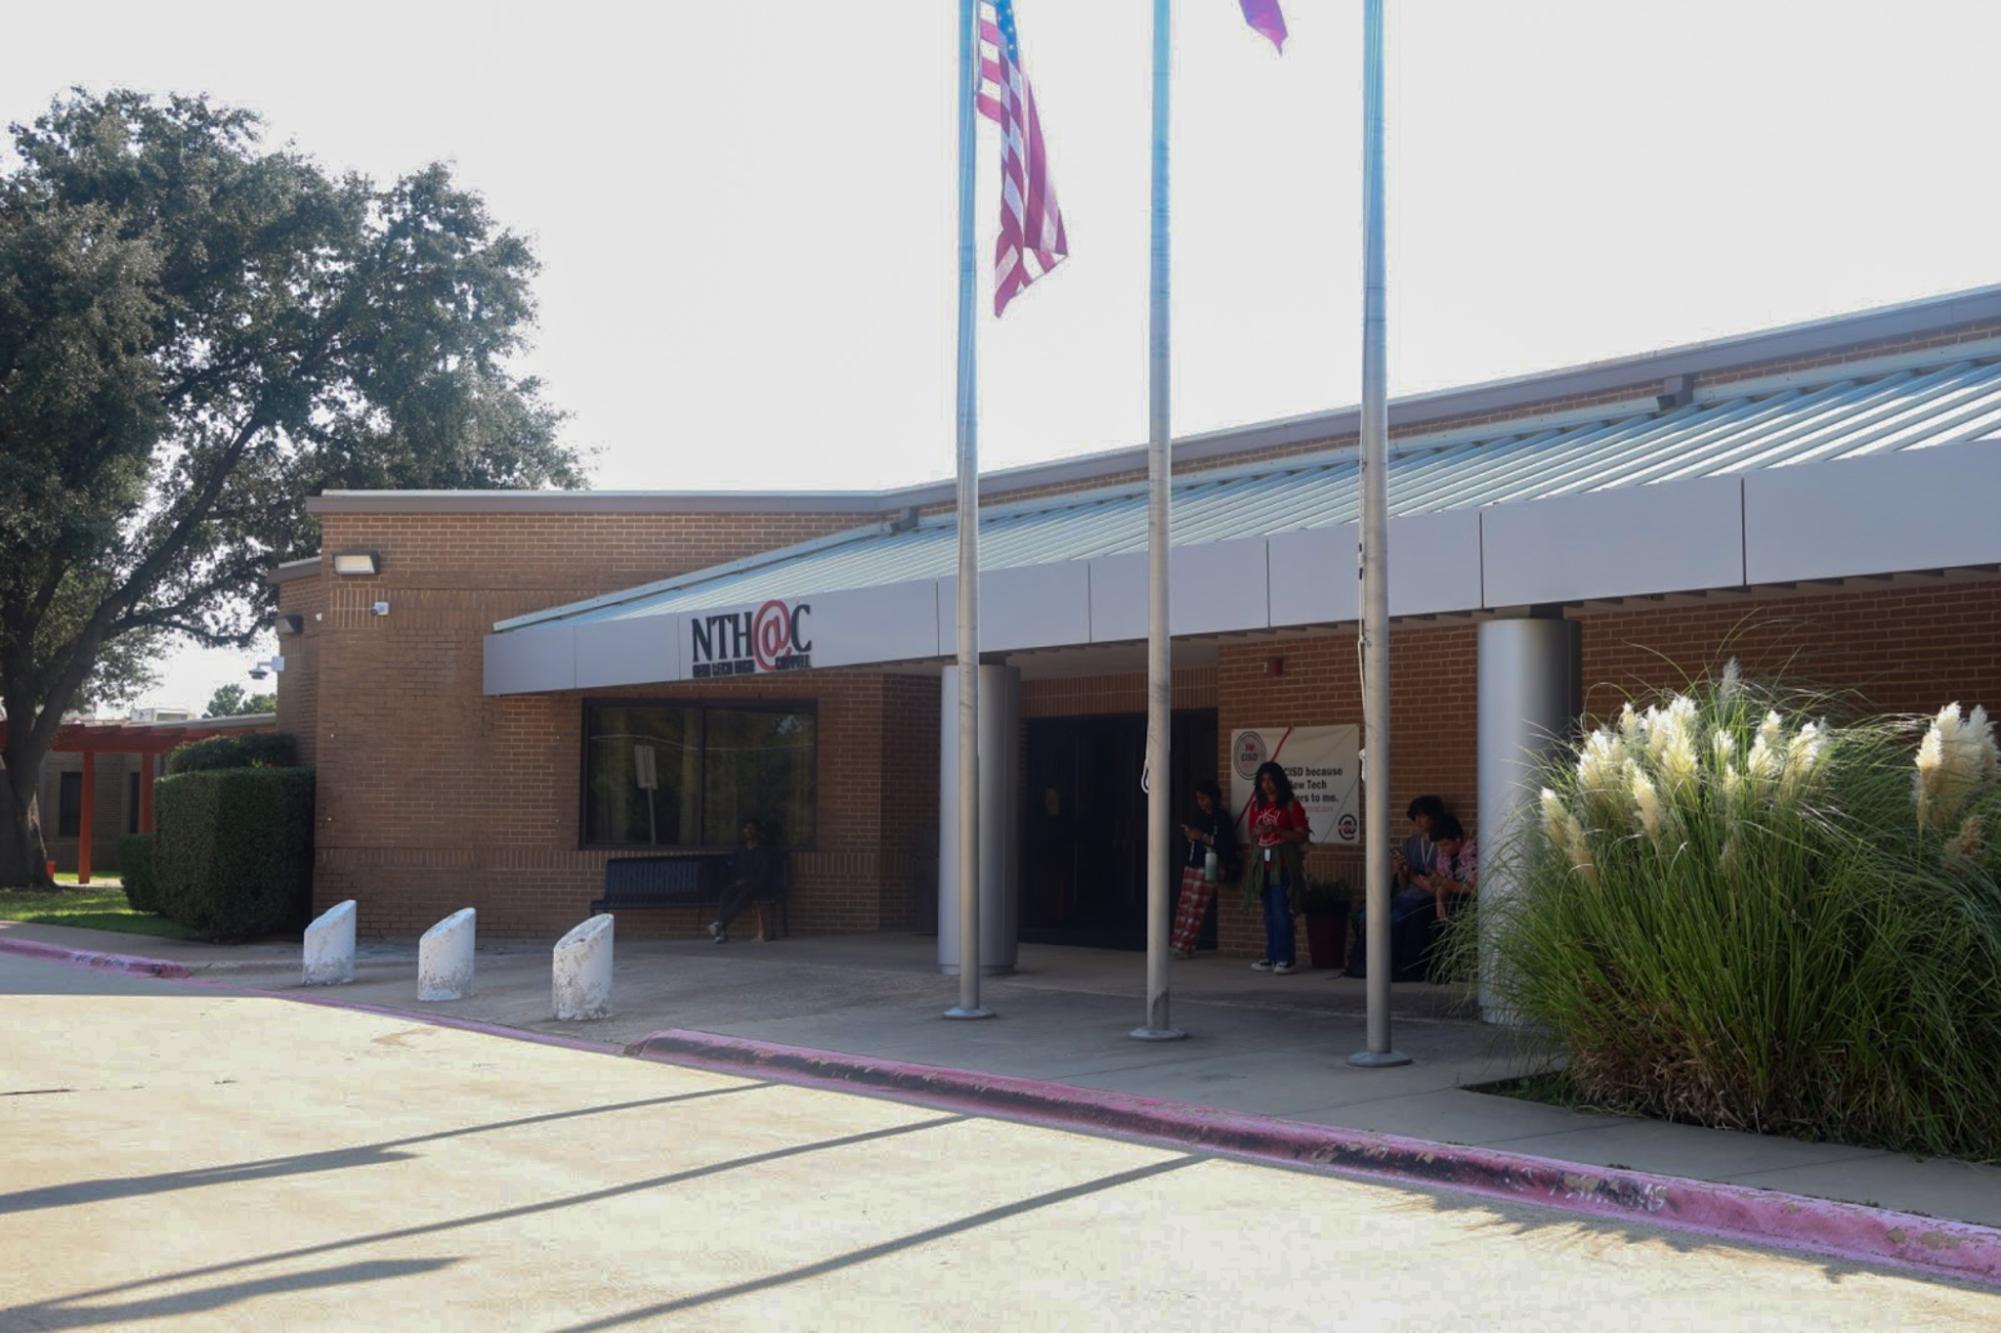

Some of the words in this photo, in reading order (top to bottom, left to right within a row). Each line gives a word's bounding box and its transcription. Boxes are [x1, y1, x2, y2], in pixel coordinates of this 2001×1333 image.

[1305, 766, 1343, 776] because
[1306, 779, 1327, 789] Tech
[1311, 793, 1321, 802] to
